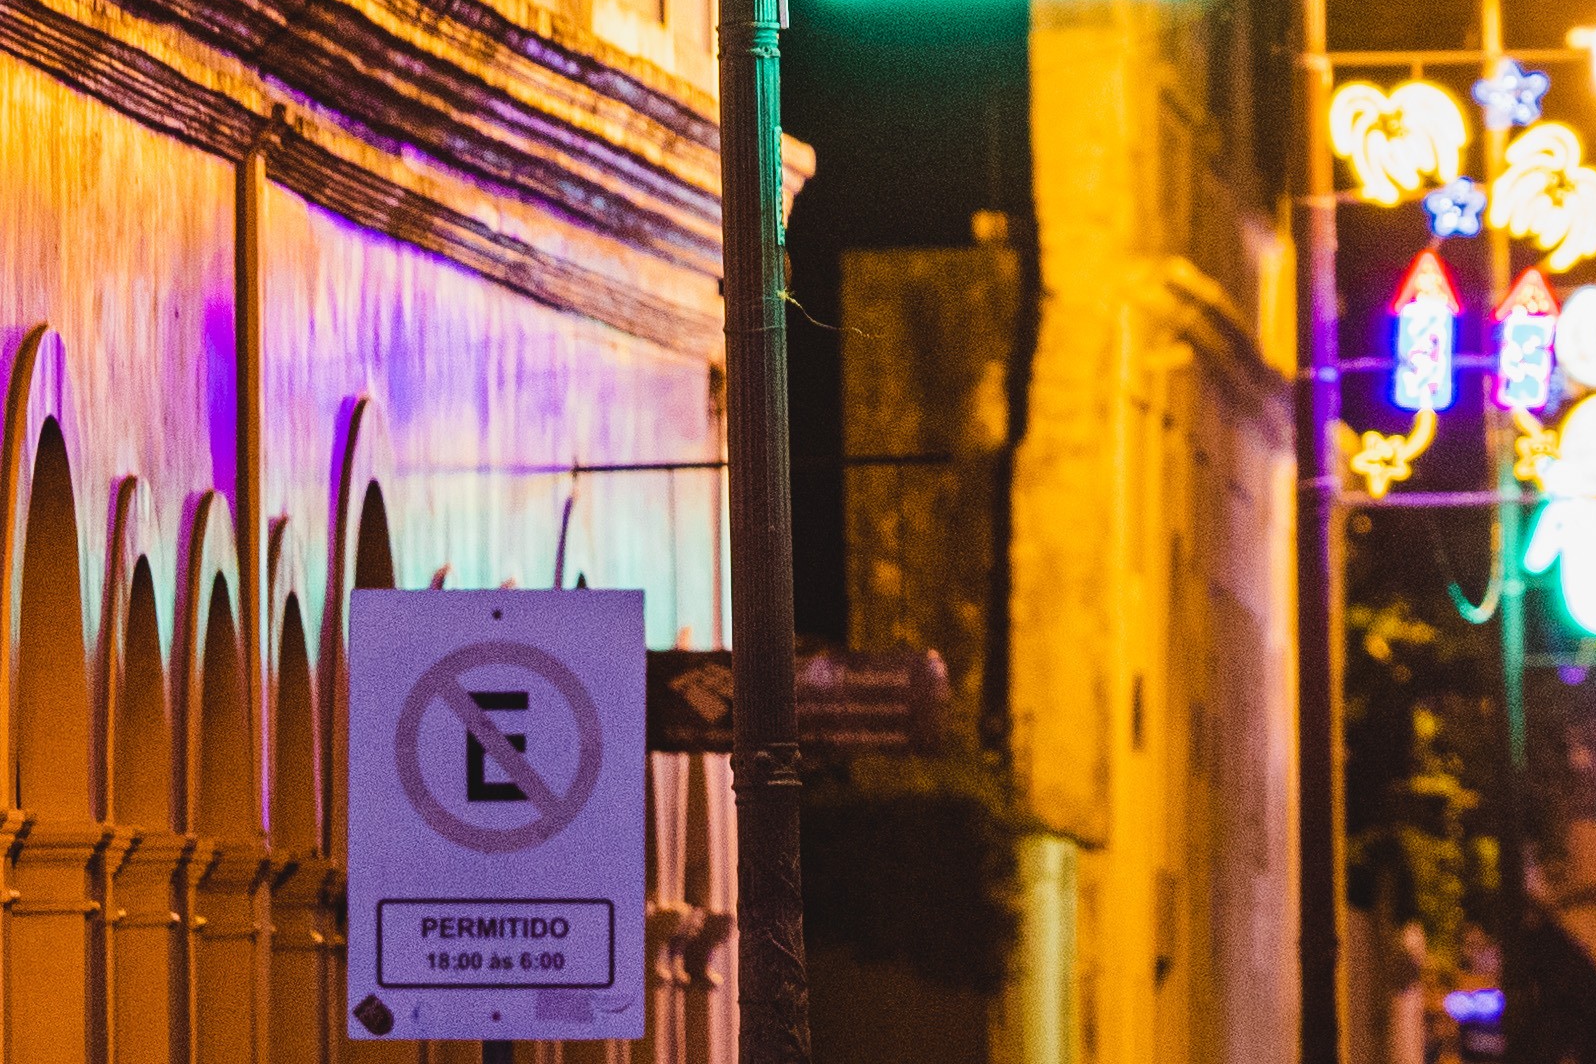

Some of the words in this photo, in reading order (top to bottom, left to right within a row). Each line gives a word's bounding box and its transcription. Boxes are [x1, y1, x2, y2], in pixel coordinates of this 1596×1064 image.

[466, 691, 529, 802] E
[420, 916, 571, 940] PERMITIDO
[427, 951, 484, 971] 18:00
[488, 951, 514, 971] às
[519, 951, 566, 971] 6:00
